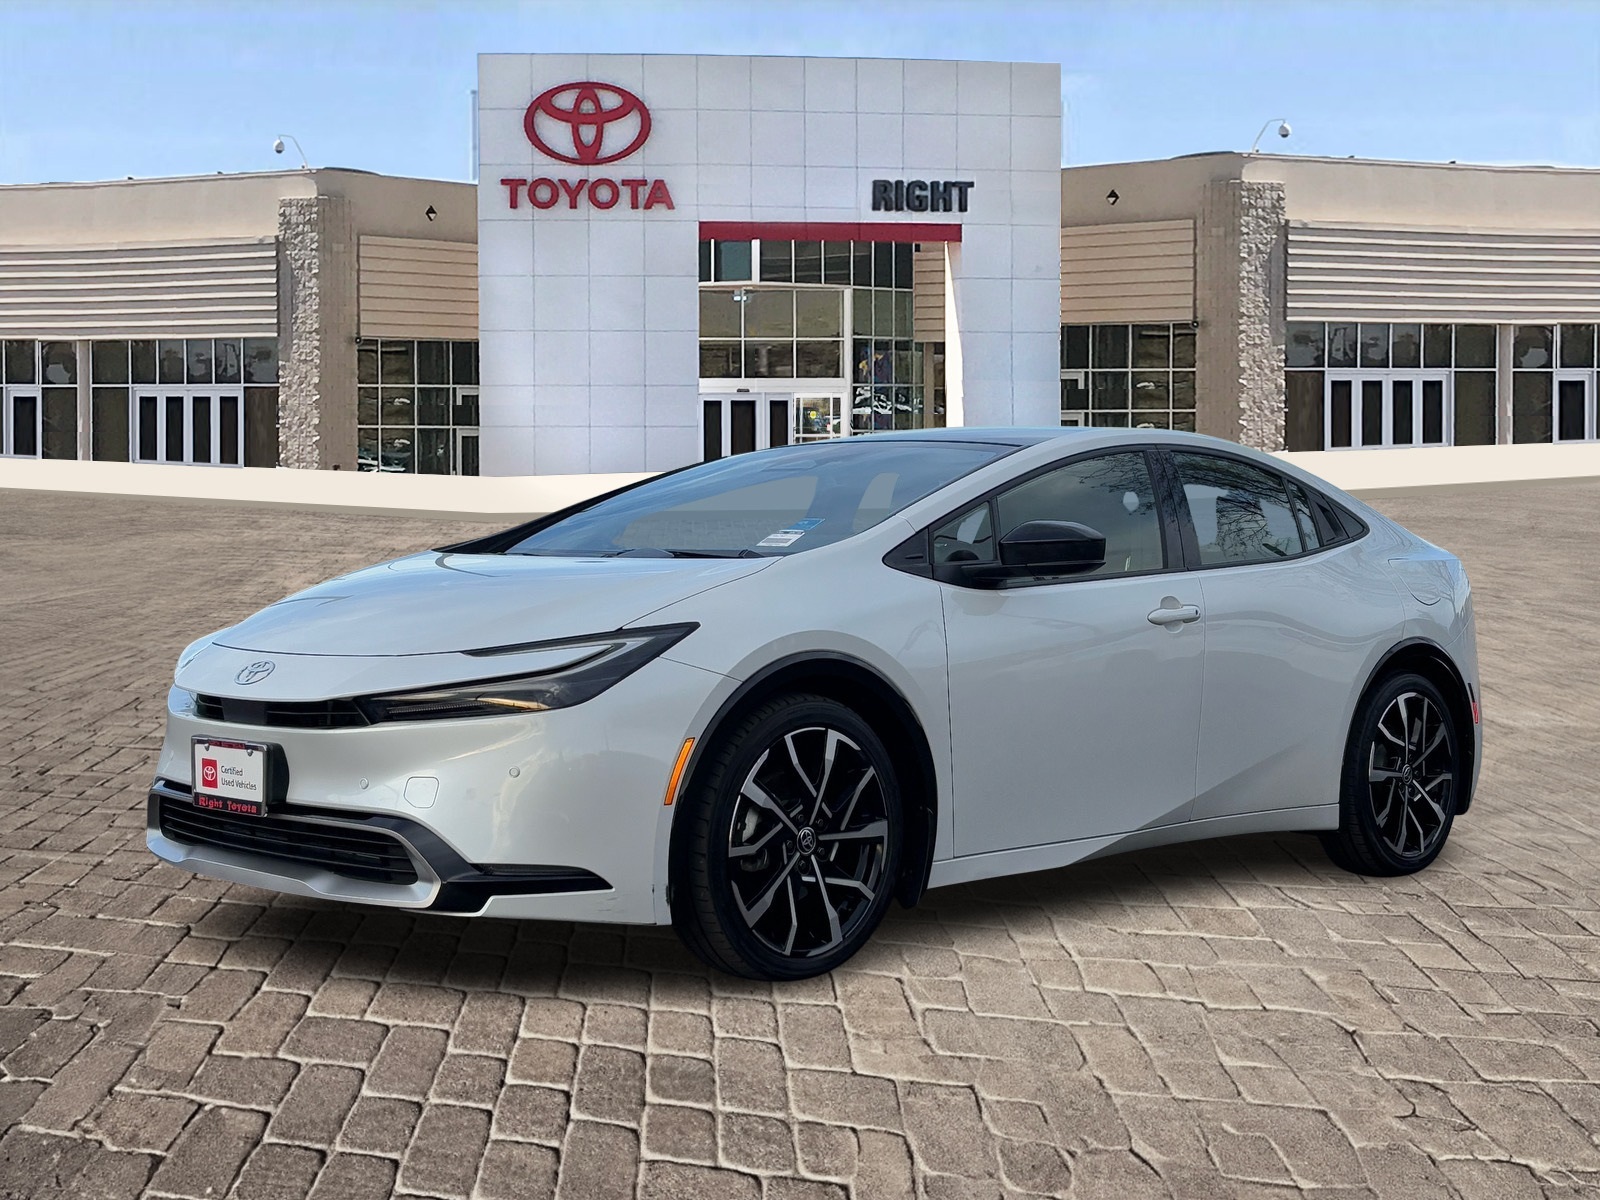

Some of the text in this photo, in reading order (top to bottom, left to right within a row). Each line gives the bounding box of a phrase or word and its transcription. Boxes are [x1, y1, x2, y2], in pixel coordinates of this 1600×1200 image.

[500, 178, 675, 209] TOYOTA
[872, 180, 974, 212] RIGHT
[221, 765, 243, 776] Certified
[221, 778, 257, 790] Used Vehicles
[198, 796, 257, 813] Right Toyota
